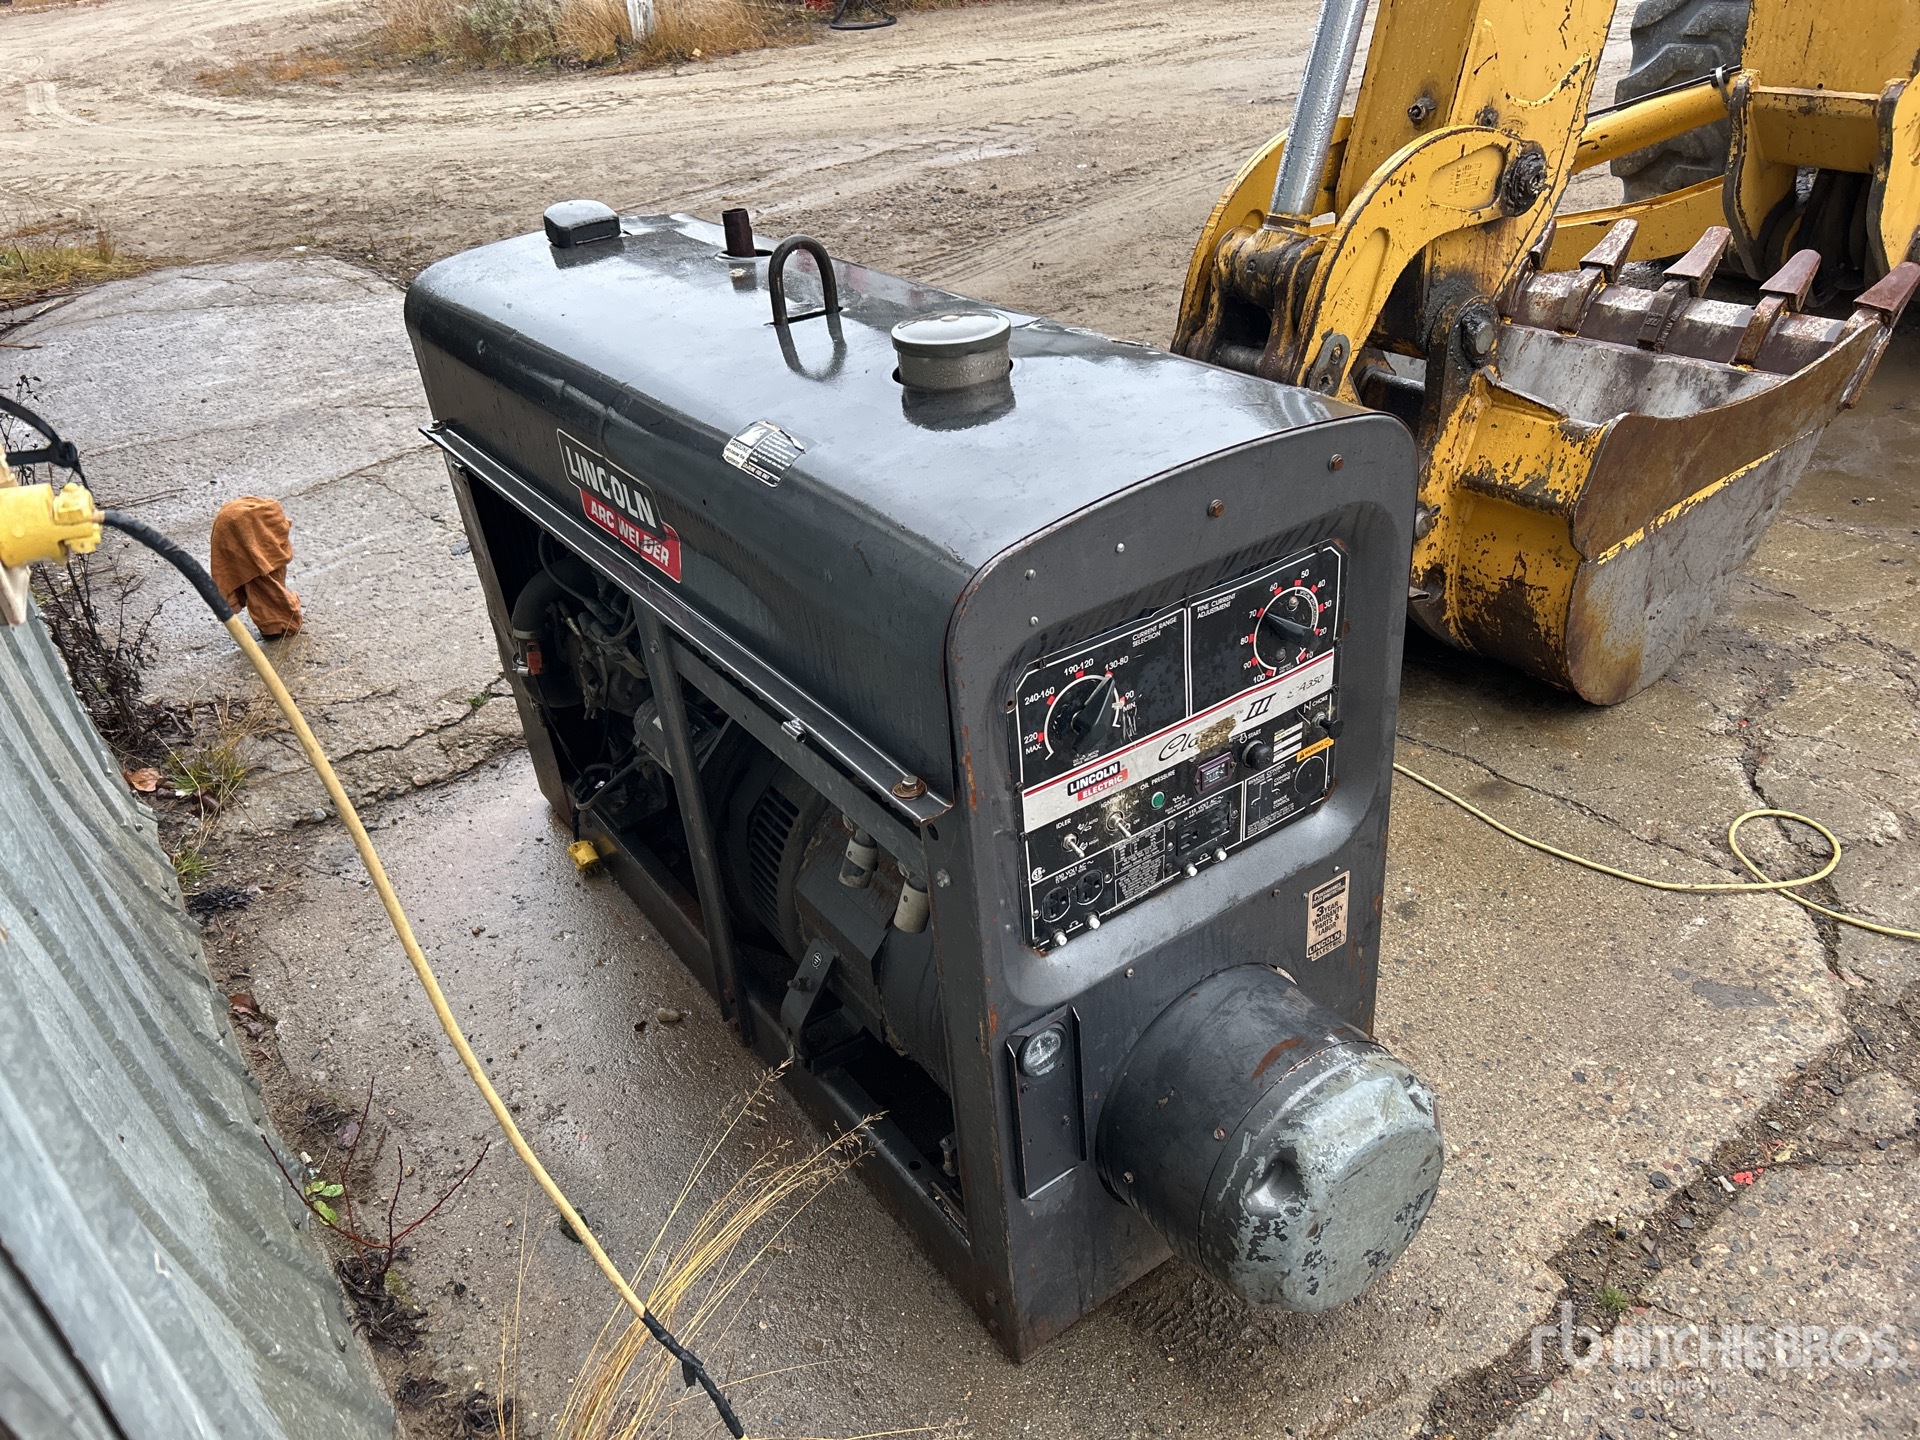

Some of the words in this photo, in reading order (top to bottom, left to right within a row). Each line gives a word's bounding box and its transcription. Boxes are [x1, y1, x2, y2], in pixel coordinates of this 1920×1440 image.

[565, 445, 657, 529] LINCOLN
[591, 500, 615, 529] ARC
[618, 515, 670, 567] WELDER
[1301, 569, 1309, 578] 50
[1270, 582, 1279, 591] 60
[1317, 579, 1326, 588] 40
[1197, 603, 1209, 613] FINE
[1211, 593, 1236, 607] CURRENT
[1197, 601, 1232, 619] ADJUSTMENT
[1324, 600, 1332, 609] 30
[1249, 610, 1257, 618] 70
[1132, 625, 1158, 641] CURRENT
[1159, 616, 1177, 630] RANGE
[1319, 627, 1327, 636] 20
[1132, 631, 1161, 647] SELECTION
[1240, 636, 1249, 645] 80
[1105, 656, 1129, 671] 130-80
[1306, 652, 1313, 660] 10
[1064, 658, 1094, 676] 190-120
[1243, 661, 1252, 669] 90
[1253, 673, 1266, 684] 100
[1024, 687, 1055, 705] 240-160
[1125, 690, 1135, 699] 90
[1242, 692, 1277, 722] III
[1024, 732, 1038, 744] 220
[1248, 729, 1261, 739] START
[1070, 763, 1118, 793] LINCOLN
[1152, 769, 1175, 785] PRESSURE
[1082, 775, 1123, 798] ELECTRIC
[1055, 818, 1071, 829] IDLER
[1312, 904, 1344, 927] WARRANTY
[1316, 905, 1325, 918] 3
[1324, 901, 1338, 913] YEAR
[1315, 917, 1333, 931] PARTS
[1335, 913, 1340, 921] &
[1318, 921, 1337, 936] LABOR
[1309, 931, 1340, 954] LINCOLN
[1313, 938, 1342, 959] ELECTRIC
